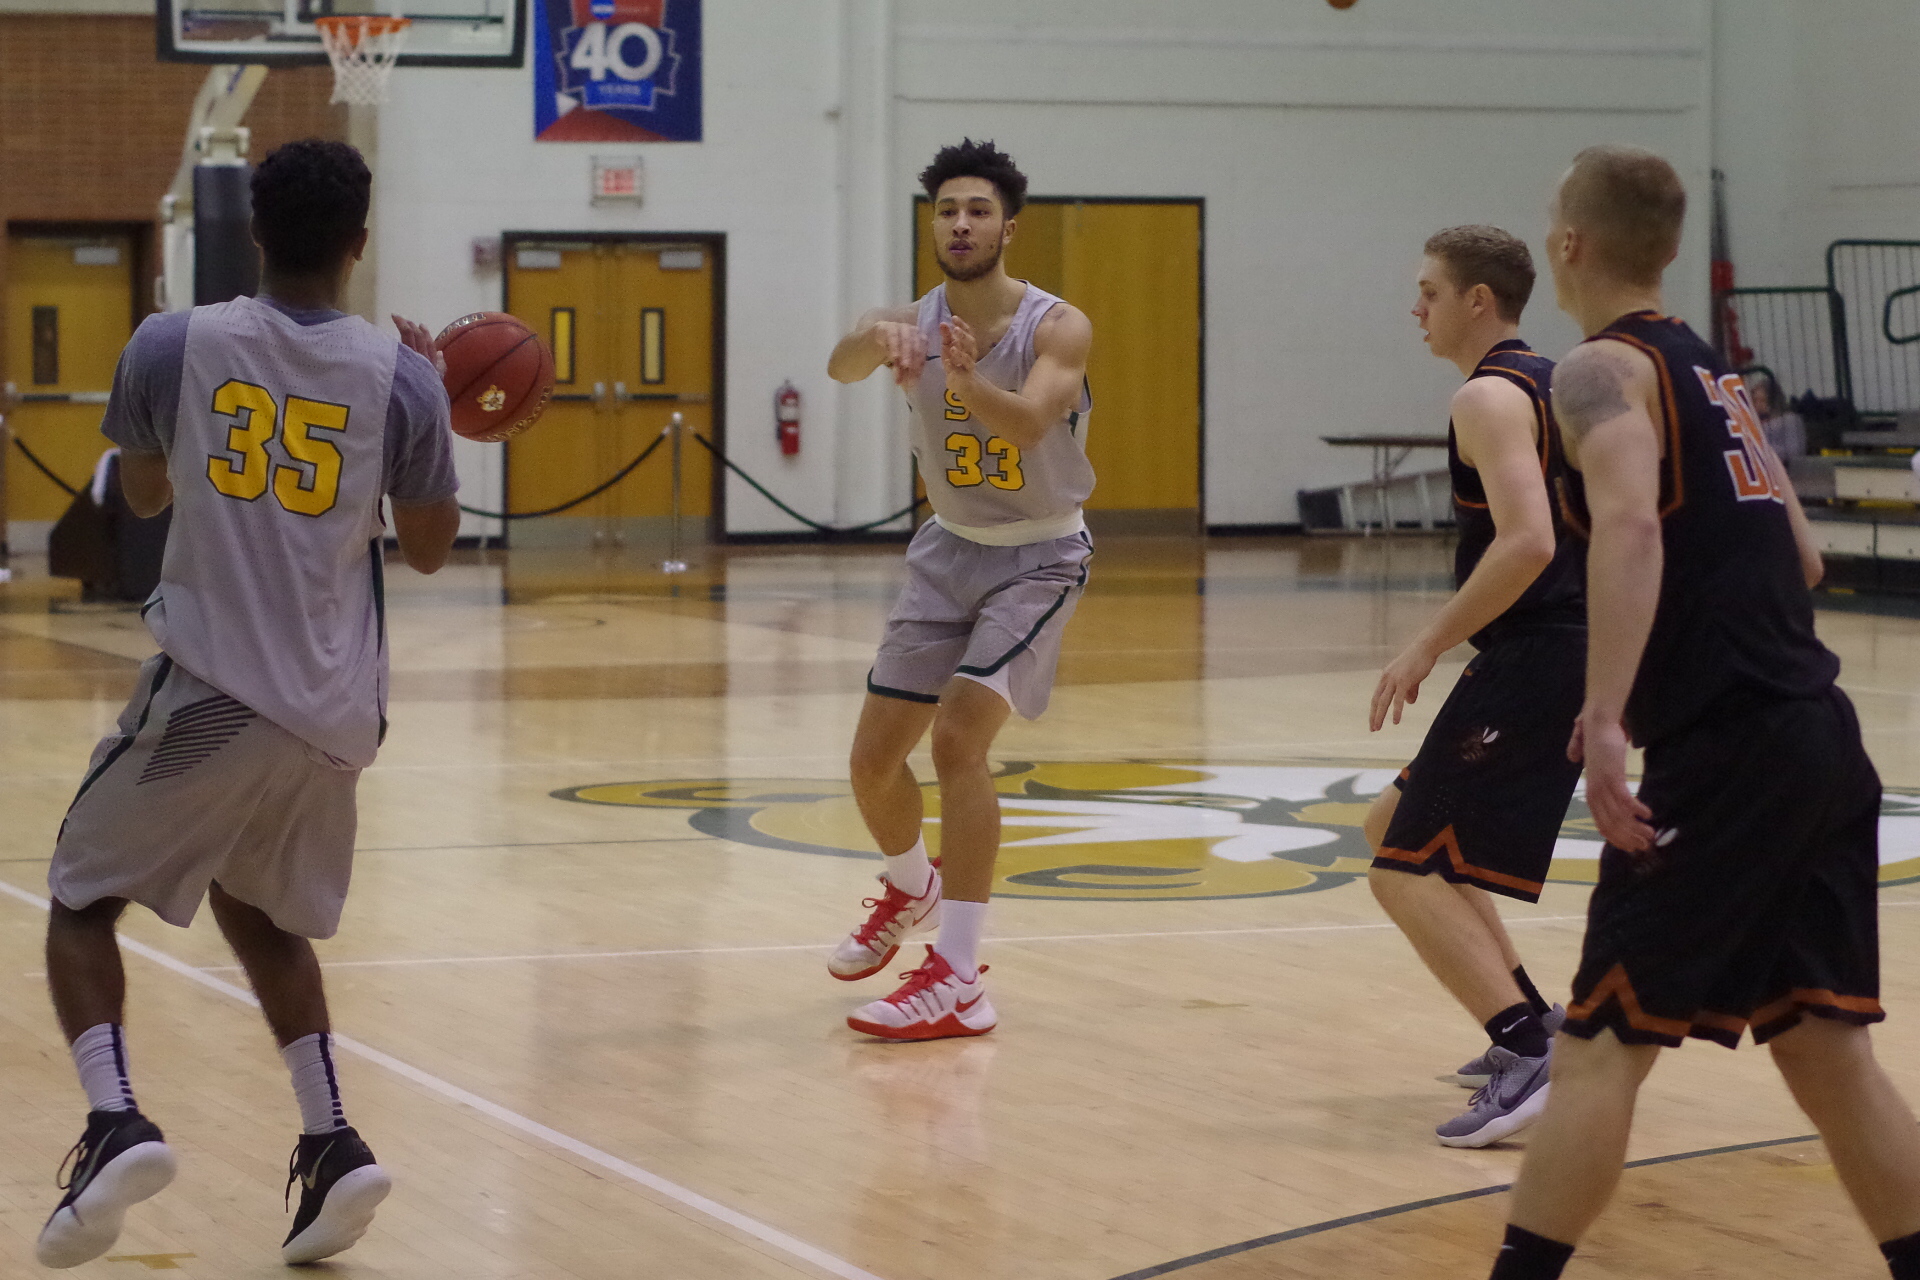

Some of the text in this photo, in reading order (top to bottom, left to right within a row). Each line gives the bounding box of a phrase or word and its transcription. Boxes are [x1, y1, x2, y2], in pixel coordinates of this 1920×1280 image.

[571, 22, 663, 81] 40
[206, 378, 351, 518] 35
[945, 432, 1025, 491] 33
